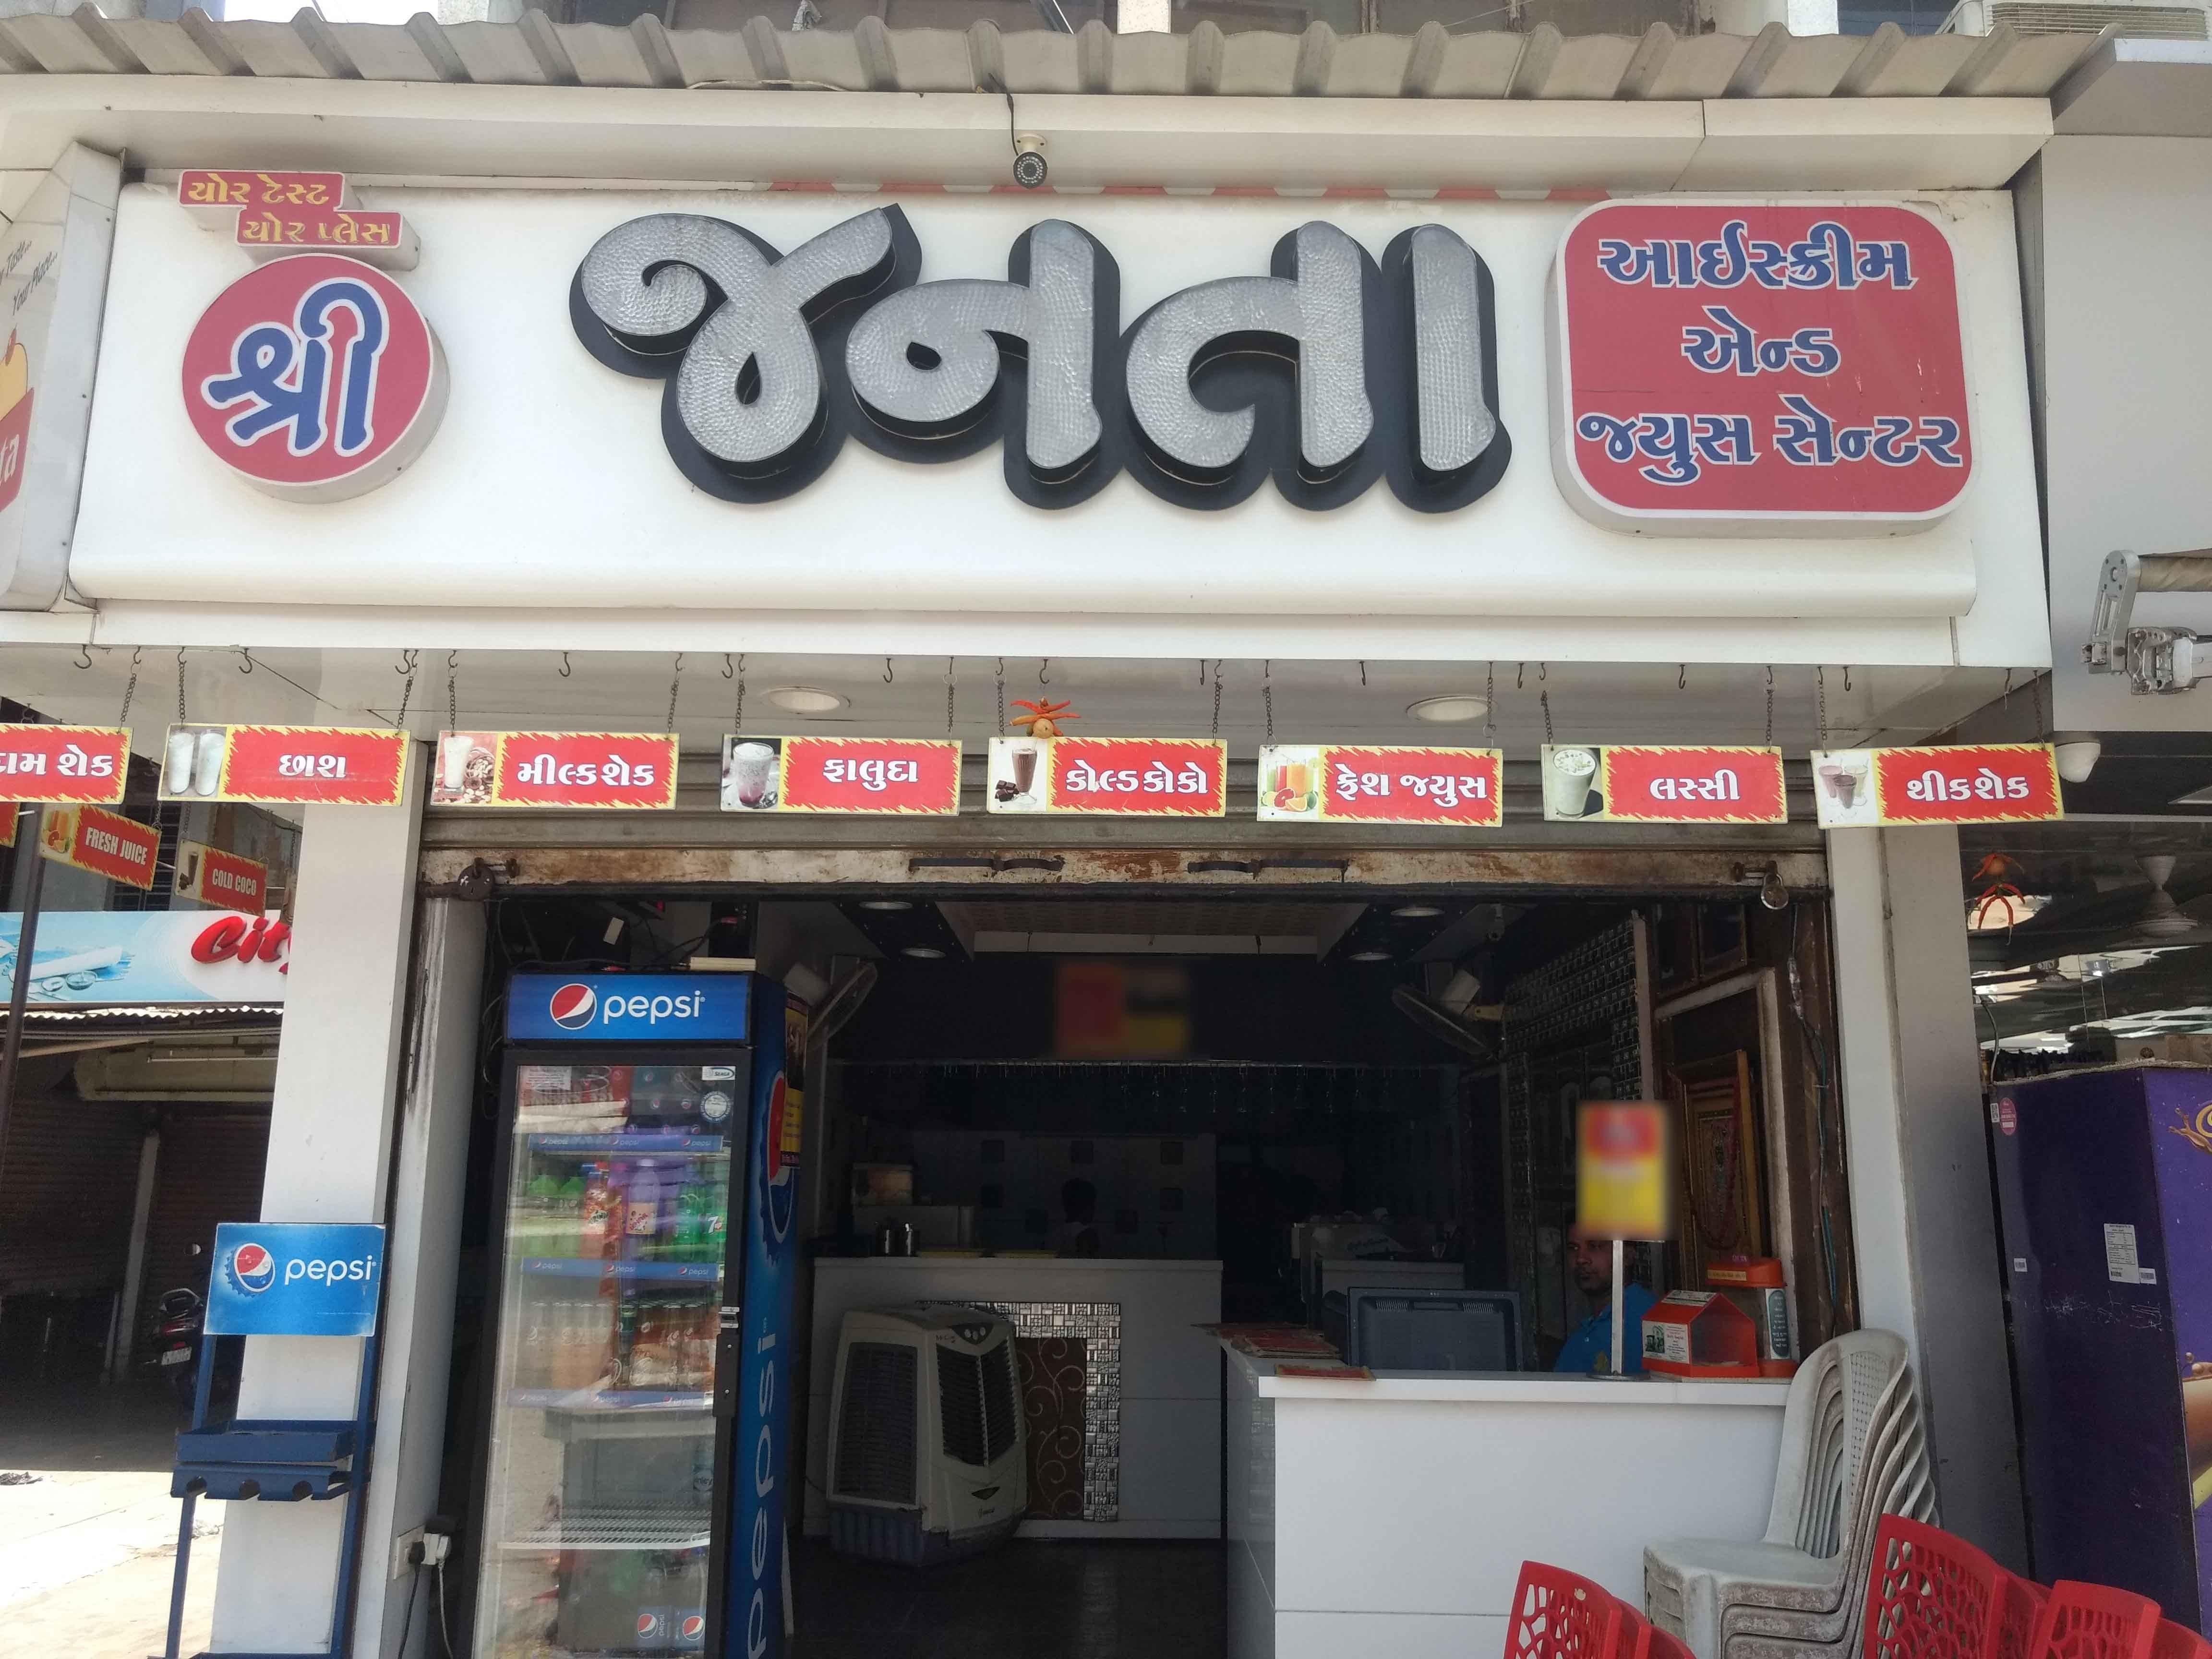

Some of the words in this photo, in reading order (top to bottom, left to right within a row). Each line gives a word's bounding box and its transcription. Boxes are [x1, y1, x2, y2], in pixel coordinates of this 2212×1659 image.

[188, 173, 250, 204] યોર
[257, 173, 329, 205] ટેસ્ટ
[242, 212, 305, 242] યોર
[318, 214, 391, 243] પ્લેસ
[571, 204, 1510, 506] જનતા
[1681, 305, 1841, 376] એન્ડ
[201, 277, 390, 457] શ્રી
[1772, 394, 1964, 468] સેન્ટર
[57, 744, 113, 777] શેક
[278, 754, 347, 779] છાશ
[822, 758, 918, 792] ફાલુદા
[1649, 769, 1740, 800] લસ્સી
[85, 827, 119, 855] FRESH
[120, 839, 148, 866] JUICE
[212, 868, 233, 889] COLD
[235, 875, 257, 897] COCO
[191, 916, 291, 974] Cit
[603, 990, 701, 1024] pepsi
[690, 1139, 711, 1147] pepsi
[285, 1255, 373, 1286] pepsi
[615, 1265, 636, 1273] pepsi
[688, 1267, 709, 1275] pepsi
[747, 1333, 776, 1659] pepsi
